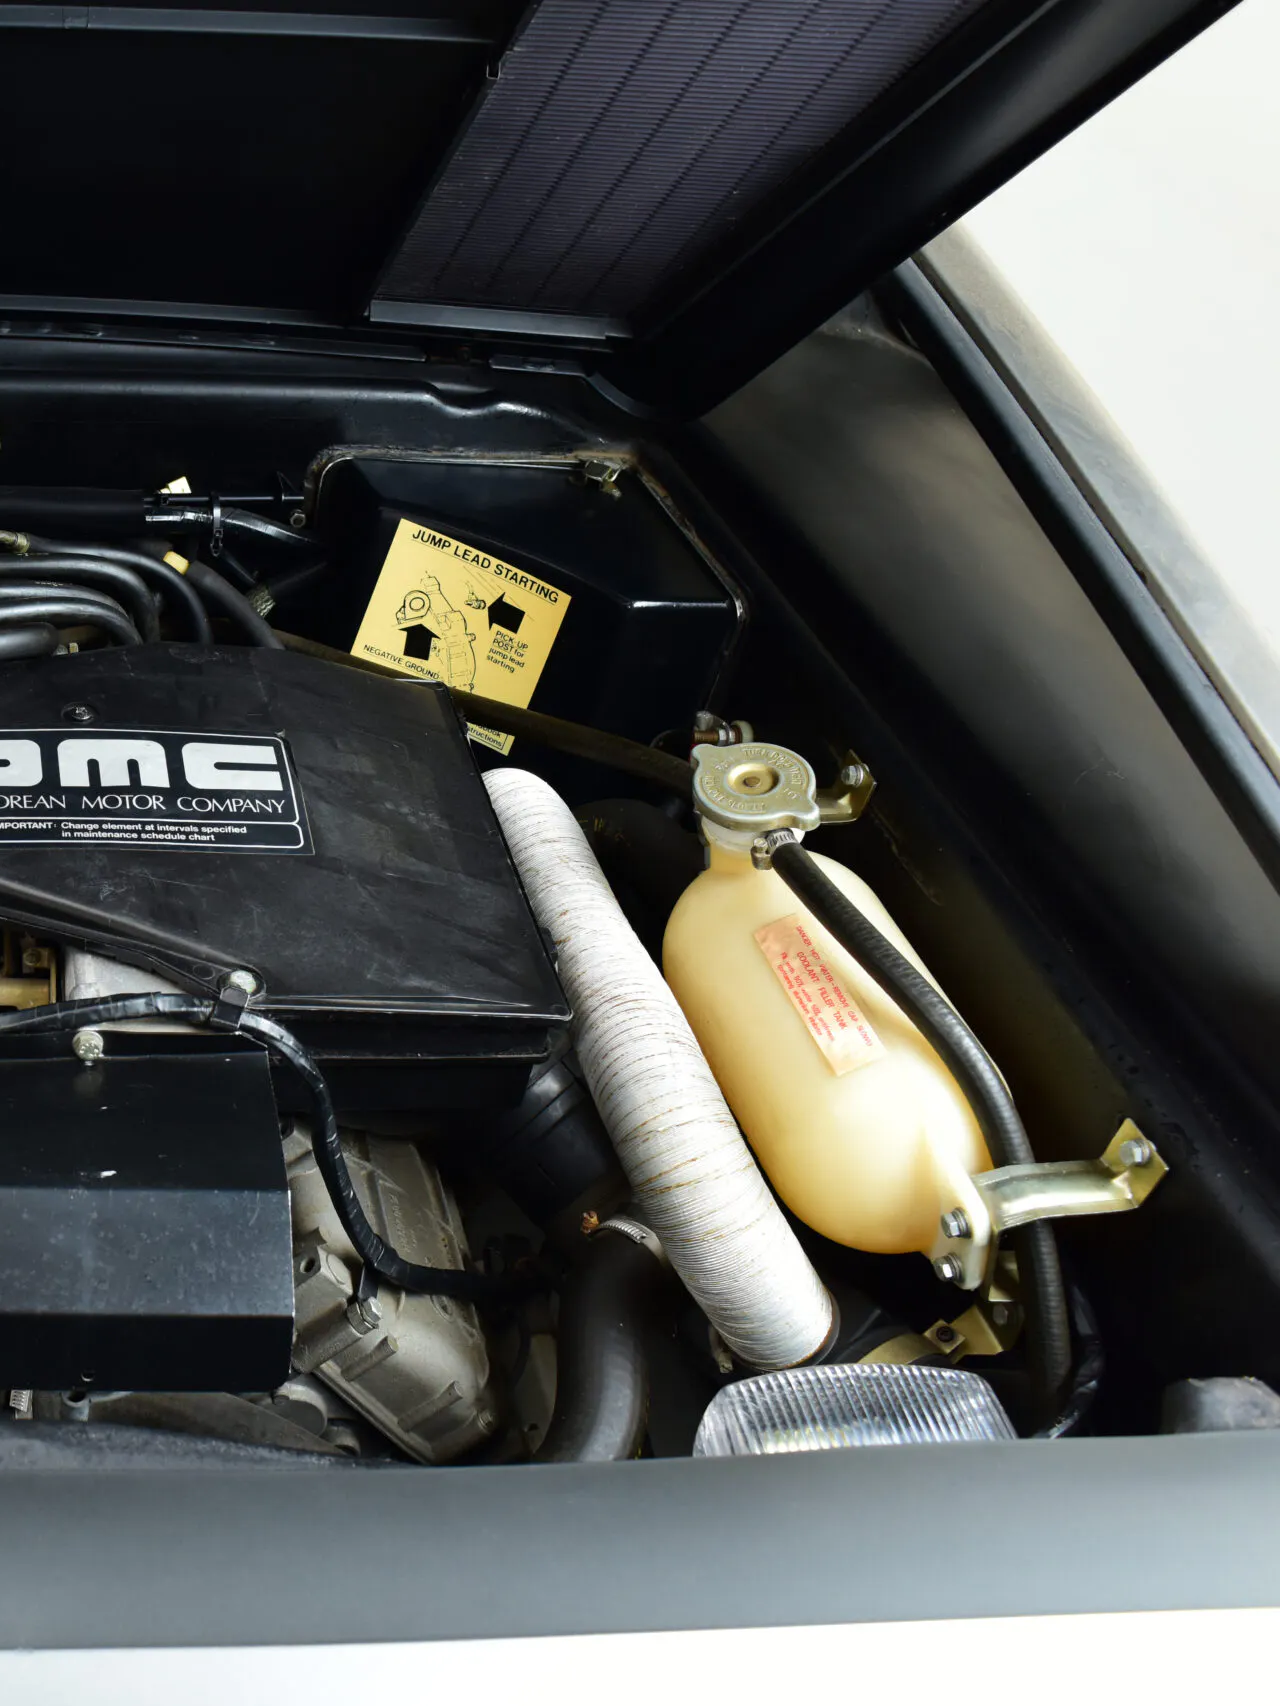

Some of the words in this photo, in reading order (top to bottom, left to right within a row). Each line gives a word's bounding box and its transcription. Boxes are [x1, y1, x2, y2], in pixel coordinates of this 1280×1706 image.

[412, 529, 451, 550] JUMP
[453, 545, 491, 569] LEAD
[494, 563, 560, 604] STARTING
[488, 647, 508, 660] jump
[508, 655, 525, 668] lead
[492, 638, 515, 652] POST
[514, 649, 525, 658] for
[363, 644, 403, 664] NEGATIVE
[404, 660, 440, 680] GROUND
[486, 654, 515, 673] starting
[81, 794, 166, 810] MOTOR
[177, 796, 285, 814] COMPANY
[61, 821, 100, 832] Change
[102, 823, 142, 832] element
[144, 824, 155, 832] at
[156, 824, 199, 833] intervals
[201, 826, 247, 836] specified
[61, 830, 72, 838] in
[73, 831, 139, 840] maintenance
[140, 832, 187, 842] schedule
[188, 834, 216, 842] chart
[796, 951, 820, 983] COOLANT
[818, 986, 835, 1008] FILLER
[833, 1010, 848, 1030] TANK
